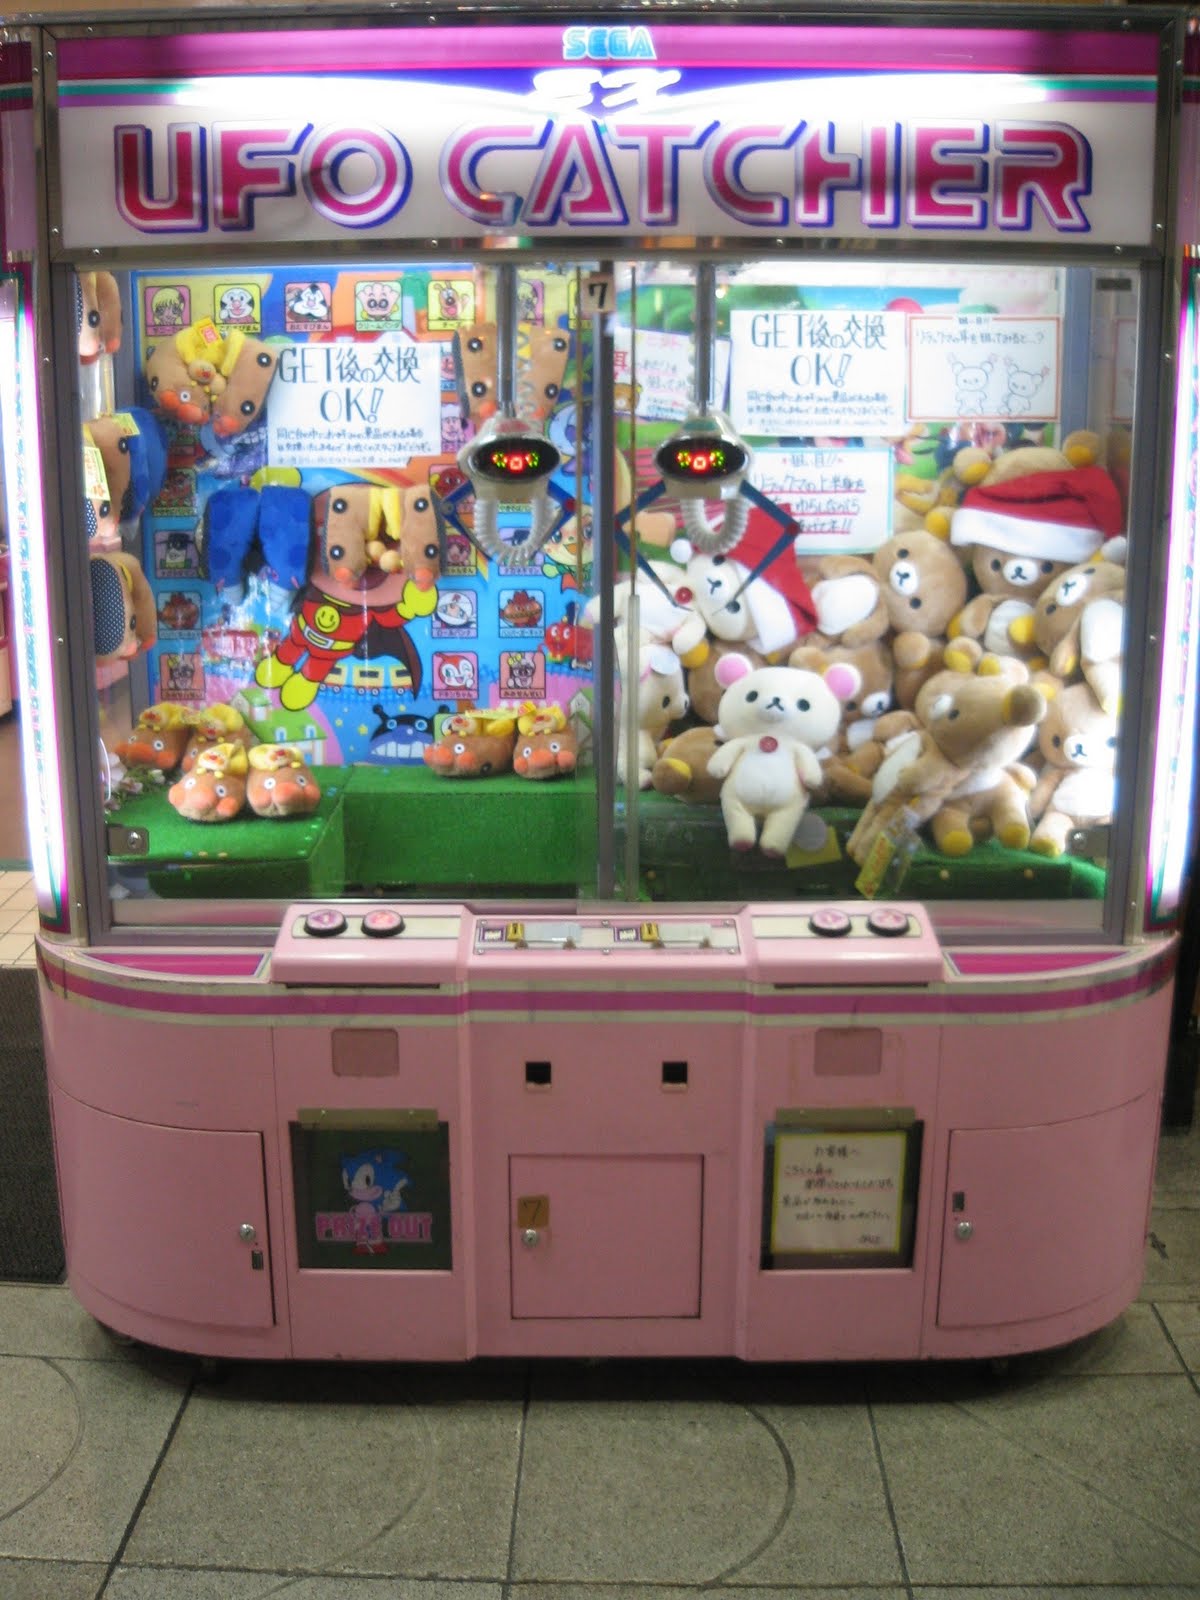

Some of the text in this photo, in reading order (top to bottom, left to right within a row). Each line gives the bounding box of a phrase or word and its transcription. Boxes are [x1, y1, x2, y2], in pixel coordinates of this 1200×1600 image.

[562, 25, 657, 60] SEGA
[114, 119, 1093, 233] UFO CATCHER
[588, 282, 608, 309] 7
[790, 353, 852, 388] OK!
[319, 387, 384, 423] OK!
[388, 1212, 432, 1242] OUT
[522, 1199, 541, 1226] 7
